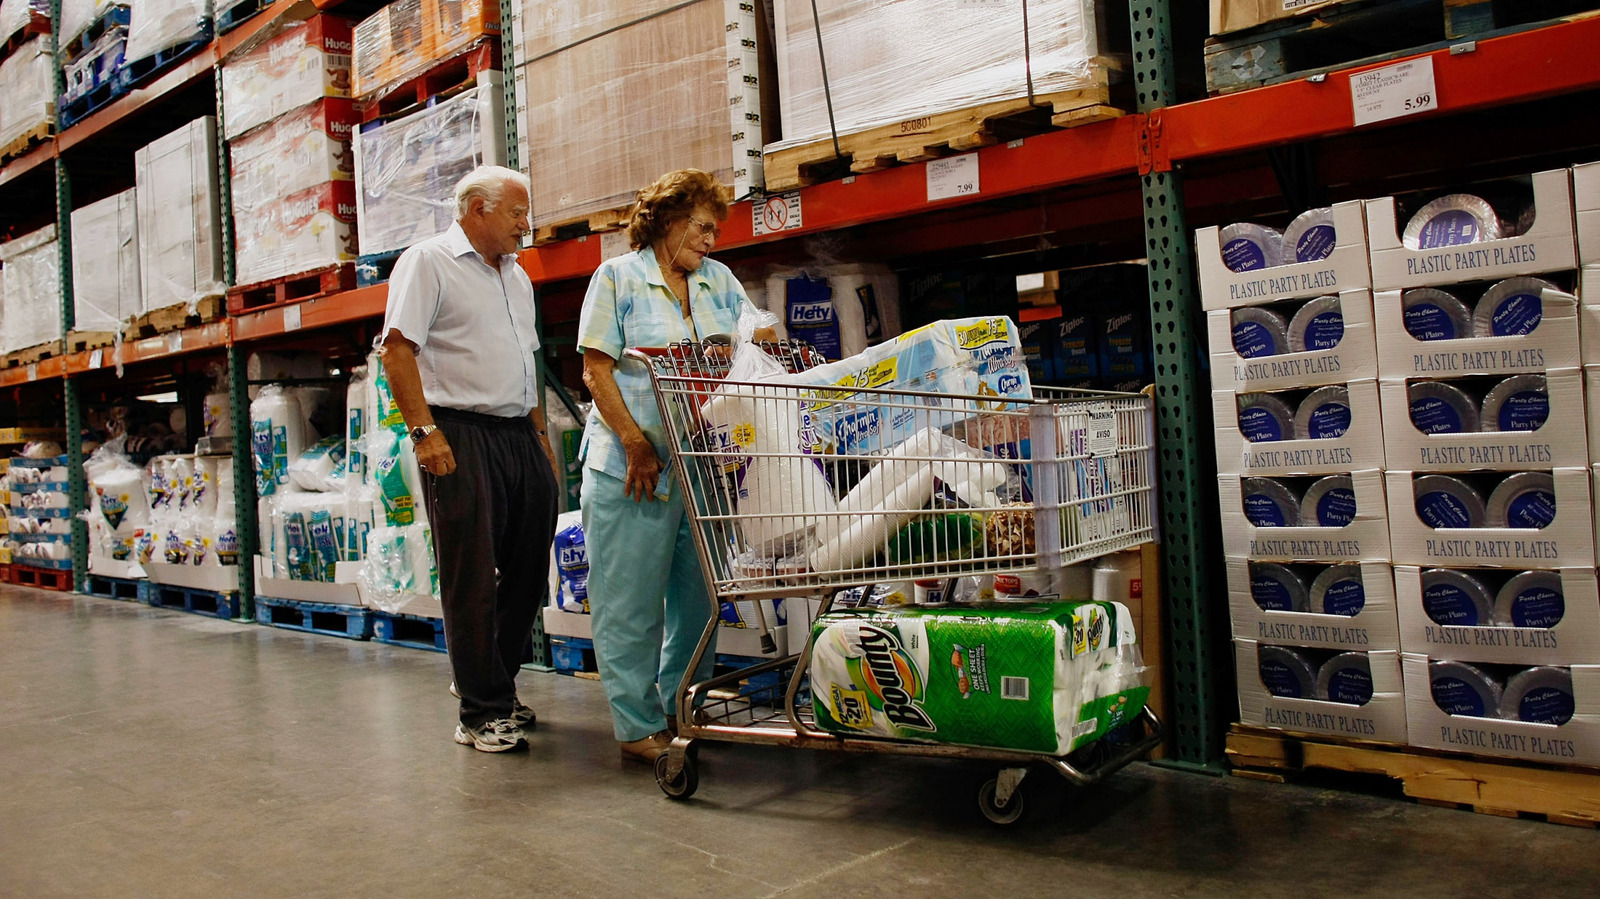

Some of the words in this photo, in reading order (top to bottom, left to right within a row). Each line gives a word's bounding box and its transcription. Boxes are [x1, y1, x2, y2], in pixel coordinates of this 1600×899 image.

[325, 37, 351, 50] HUGG
[1405, 94, 1430, 110] 5.99
[957, 184, 973, 193] 7.99
[1407, 254, 1450, 275] PLASTIC
[1455, 249, 1489, 270] PARTY
[1493, 244, 1535, 265] PLATES
[1230, 279, 1267, 299] PLASTIC
[1270, 275, 1298, 295] PARTY
[1301, 270, 1336, 290] PLATES
[793, 305, 830, 320] Hefty
[986, 318, 998, 336] 75
[1059, 316, 1084, 337] Ziploc
[1106, 313, 1132, 334] Ziploc
[1315, 339, 1329, 348] Party
[1234, 362, 1269, 381] PLASTIC
[1271, 360, 1301, 378] PARTY
[1305, 355, 1341, 375] PLATES
[1414, 353, 1458, 371] PLASTIC
[1463, 351, 1497, 369] PARTY
[1501, 349, 1544, 367] PLATES
[851, 367, 870, 388] 75
[1092, 411, 1113, 420] WARNING
[1511, 421, 1528, 429] Party
[1096, 430, 1111, 438] AVISO
[1244, 452, 1280, 468] PLASTIC
[1283, 450, 1313, 466] PARTY
[1317, 447, 1352, 464] PLATES
[1421, 447, 1466, 464] PLASTIC
[1470, 445, 1504, 463] PARTY
[1509, 444, 1551, 462] PLATES
[1250, 540, 1288, 556] PLASTIC
[1291, 540, 1320, 556] PARTY
[1324, 540, 1360, 556] PLATES
[1426, 539, 1470, 557] PLASTIC
[1475, 540, 1510, 558] PARTY
[1515, 541, 1557, 559] PLATES
[1258, 622, 1296, 640] PLASTIC
[1299, 625, 1329, 642] PARTY
[1332, 628, 1368, 645] PLATES
[1425, 626, 1470, 645] PLASTIC
[1475, 628, 1509, 646] PARTY
[1514, 630, 1557, 649] PLATES
[968, 648, 976, 673] SHEET
[855, 626, 937, 733] Bounty
[972, 674, 980, 690] ONE
[1265, 707, 1302, 727] PLASTIC
[1305, 712, 1335, 730] PARTY
[1339, 716, 1375, 735] PLATES
[1441, 726, 1486, 747] PLASTIC
[1491, 732, 1526, 751] PARTY
[1531, 737, 1575, 757] PLATES
